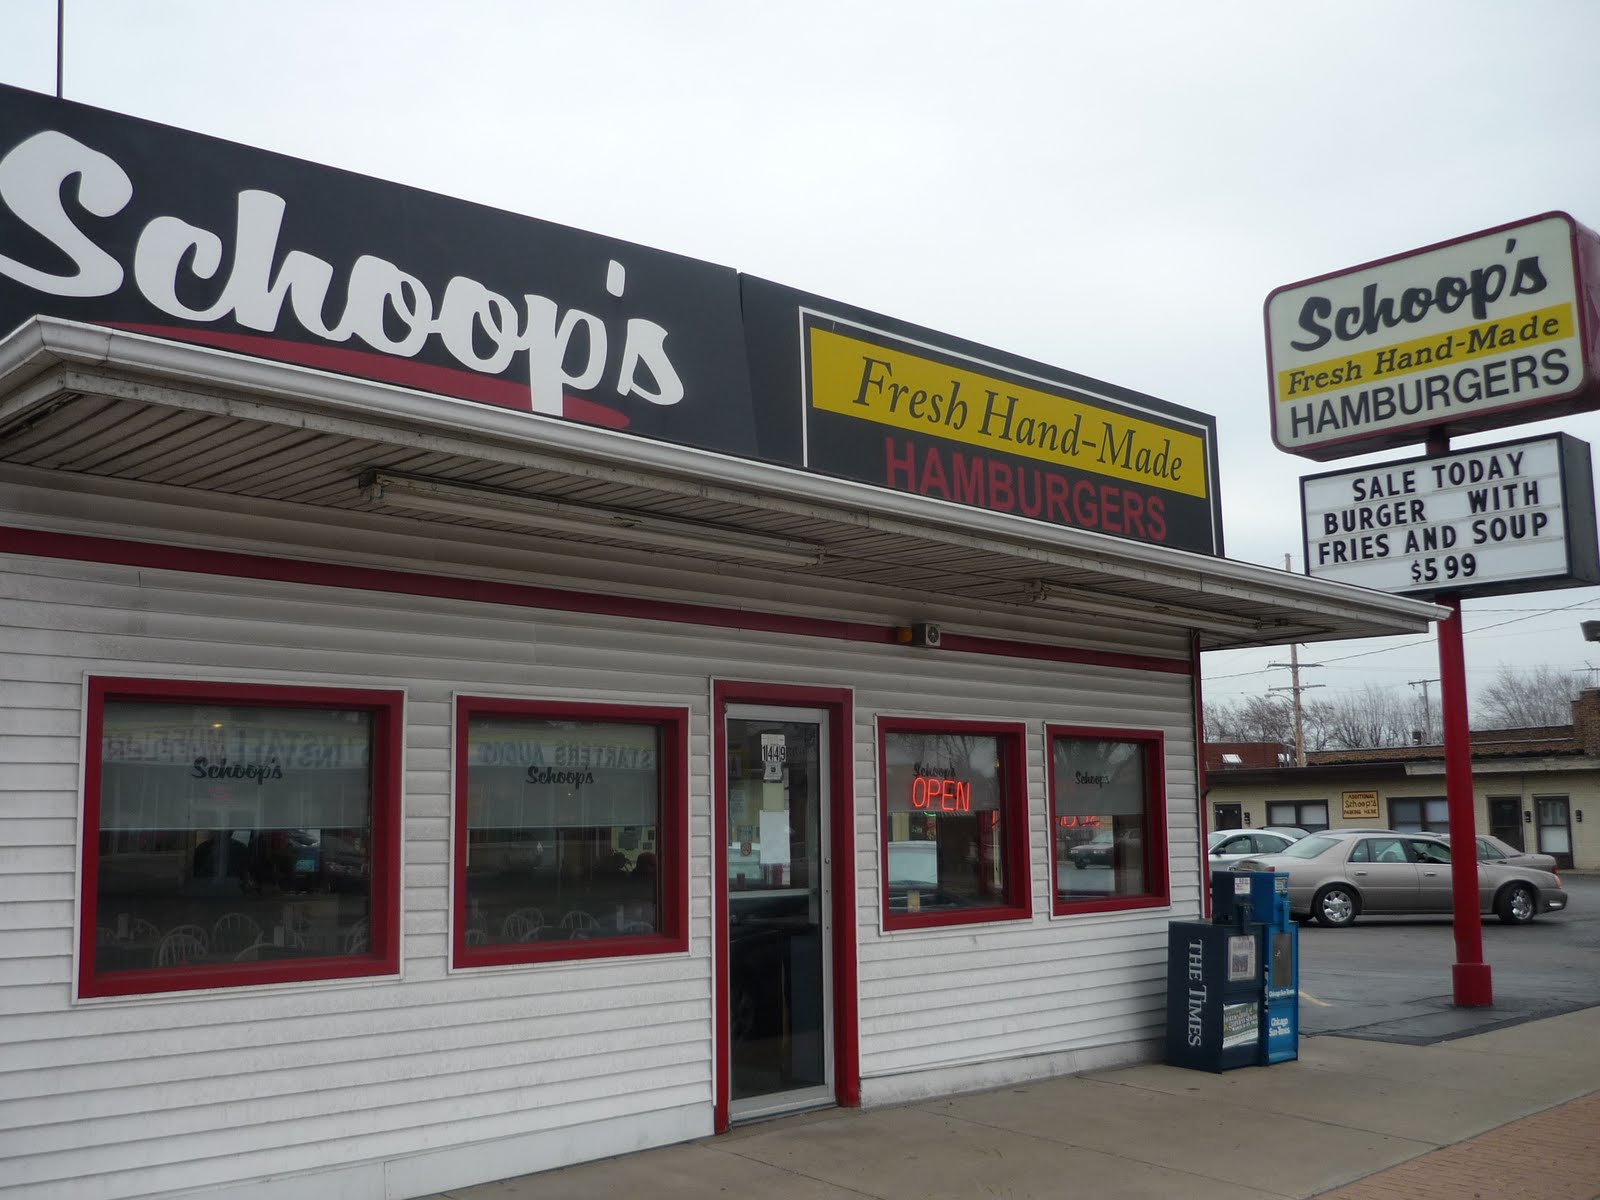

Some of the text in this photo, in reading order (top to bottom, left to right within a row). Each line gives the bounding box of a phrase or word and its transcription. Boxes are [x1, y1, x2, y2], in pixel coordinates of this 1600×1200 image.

[0, 130, 685, 416] Schoop's
[1290, 238, 1547, 352] Schoop's
[1287, 315, 1560, 395] Fresh Hand-Made
[852, 355, 1182, 481] Fresh Hand-Made
[1290, 348, 1570, 438] HAMBURGERS
[884, 436, 1167, 541] HAMBURGERS
[1323, 480, 1539, 535] BURGER WITH
[1352, 451, 1524, 502] SALE TODAY
[1318, 512, 1548, 565] FRIES AND SOUP
[191, 755, 283, 785] Schoop's
[525, 765, 595, 790] Schoop's
[762, 745, 786, 762] 1449
[912, 776, 971, 812] OPEN
[1187, 939, 1207, 1046] THE TIMES
